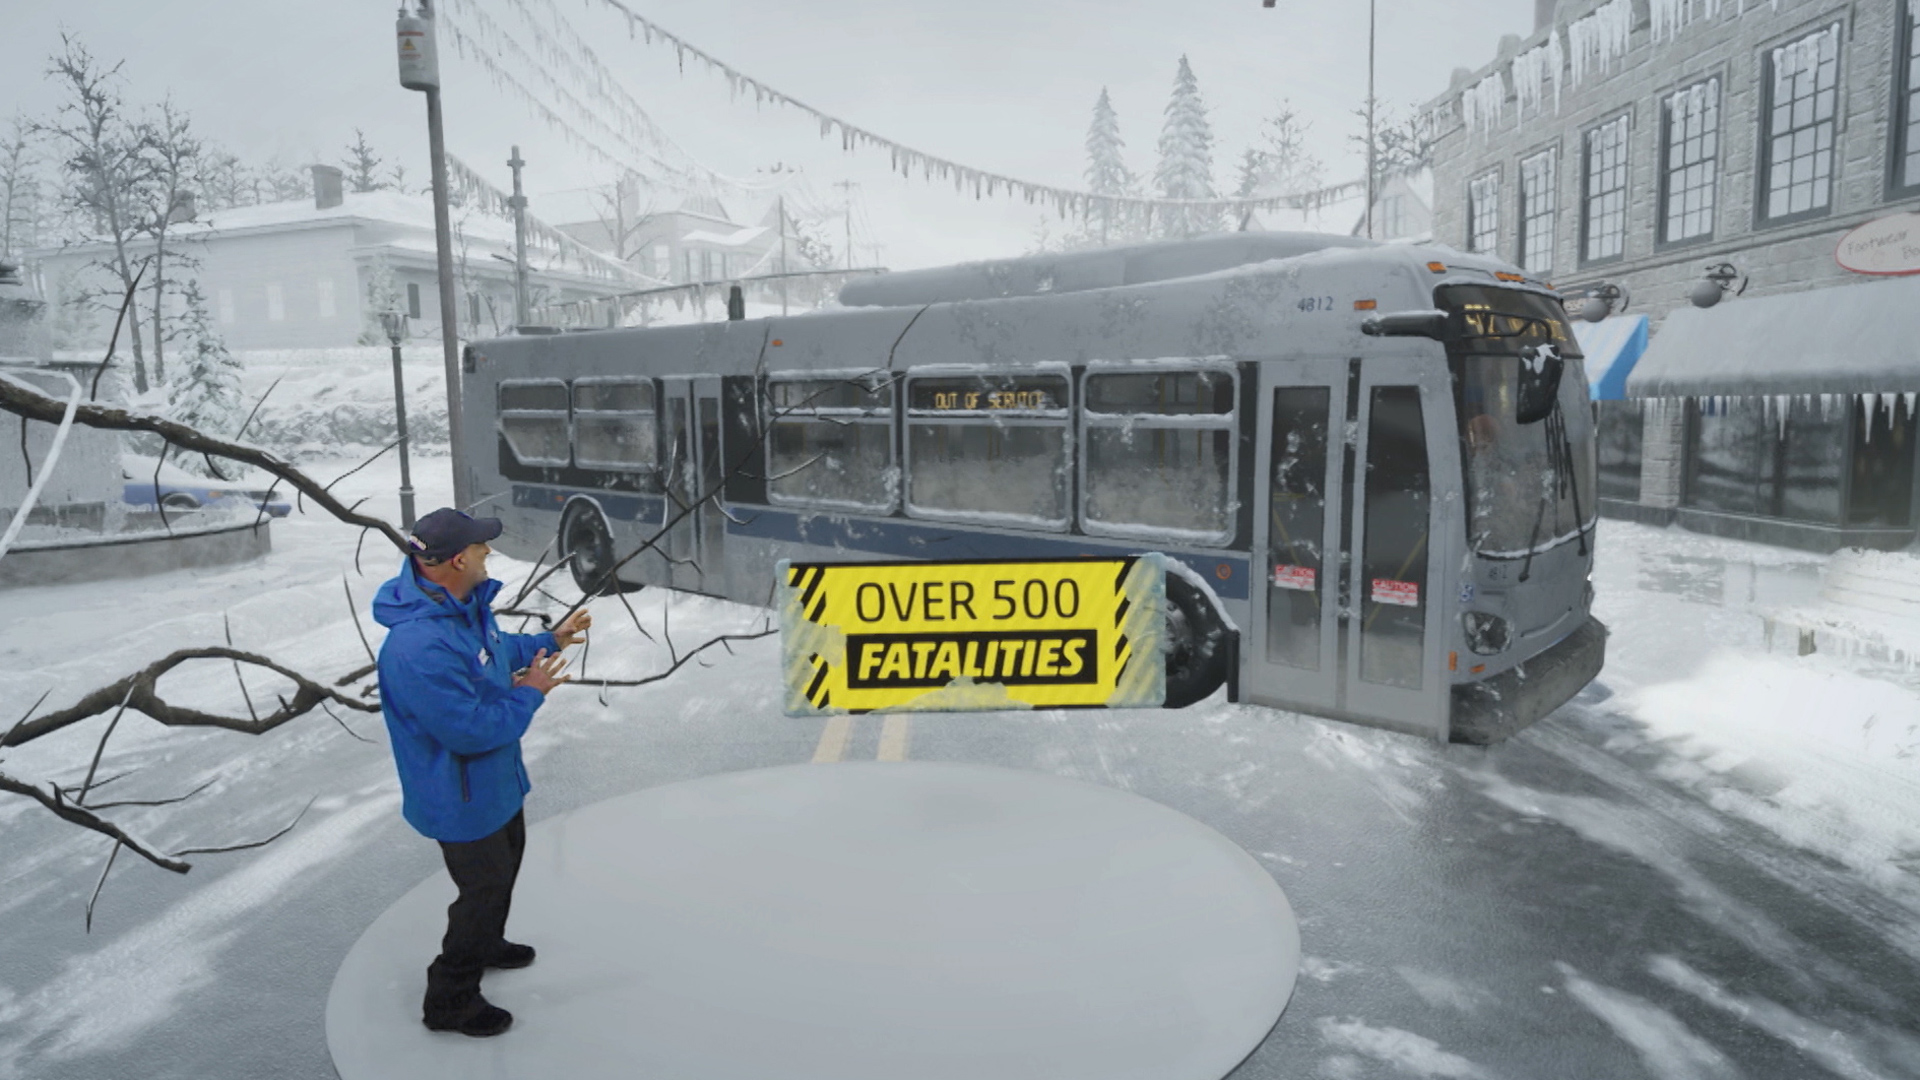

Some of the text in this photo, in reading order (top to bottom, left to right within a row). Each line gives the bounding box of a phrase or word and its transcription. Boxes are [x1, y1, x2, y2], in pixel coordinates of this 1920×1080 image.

[1297, 295, 1334, 313] 4812
[934, 391, 958, 410] OUT
[964, 391, 981, 410] OF
[1275, 564, 1316, 578] CTION
[1372, 579, 1418, 593] CAUTION
[855, 578, 1080, 623] OVER 500
[857, 637, 1087, 681] FATALITIES
